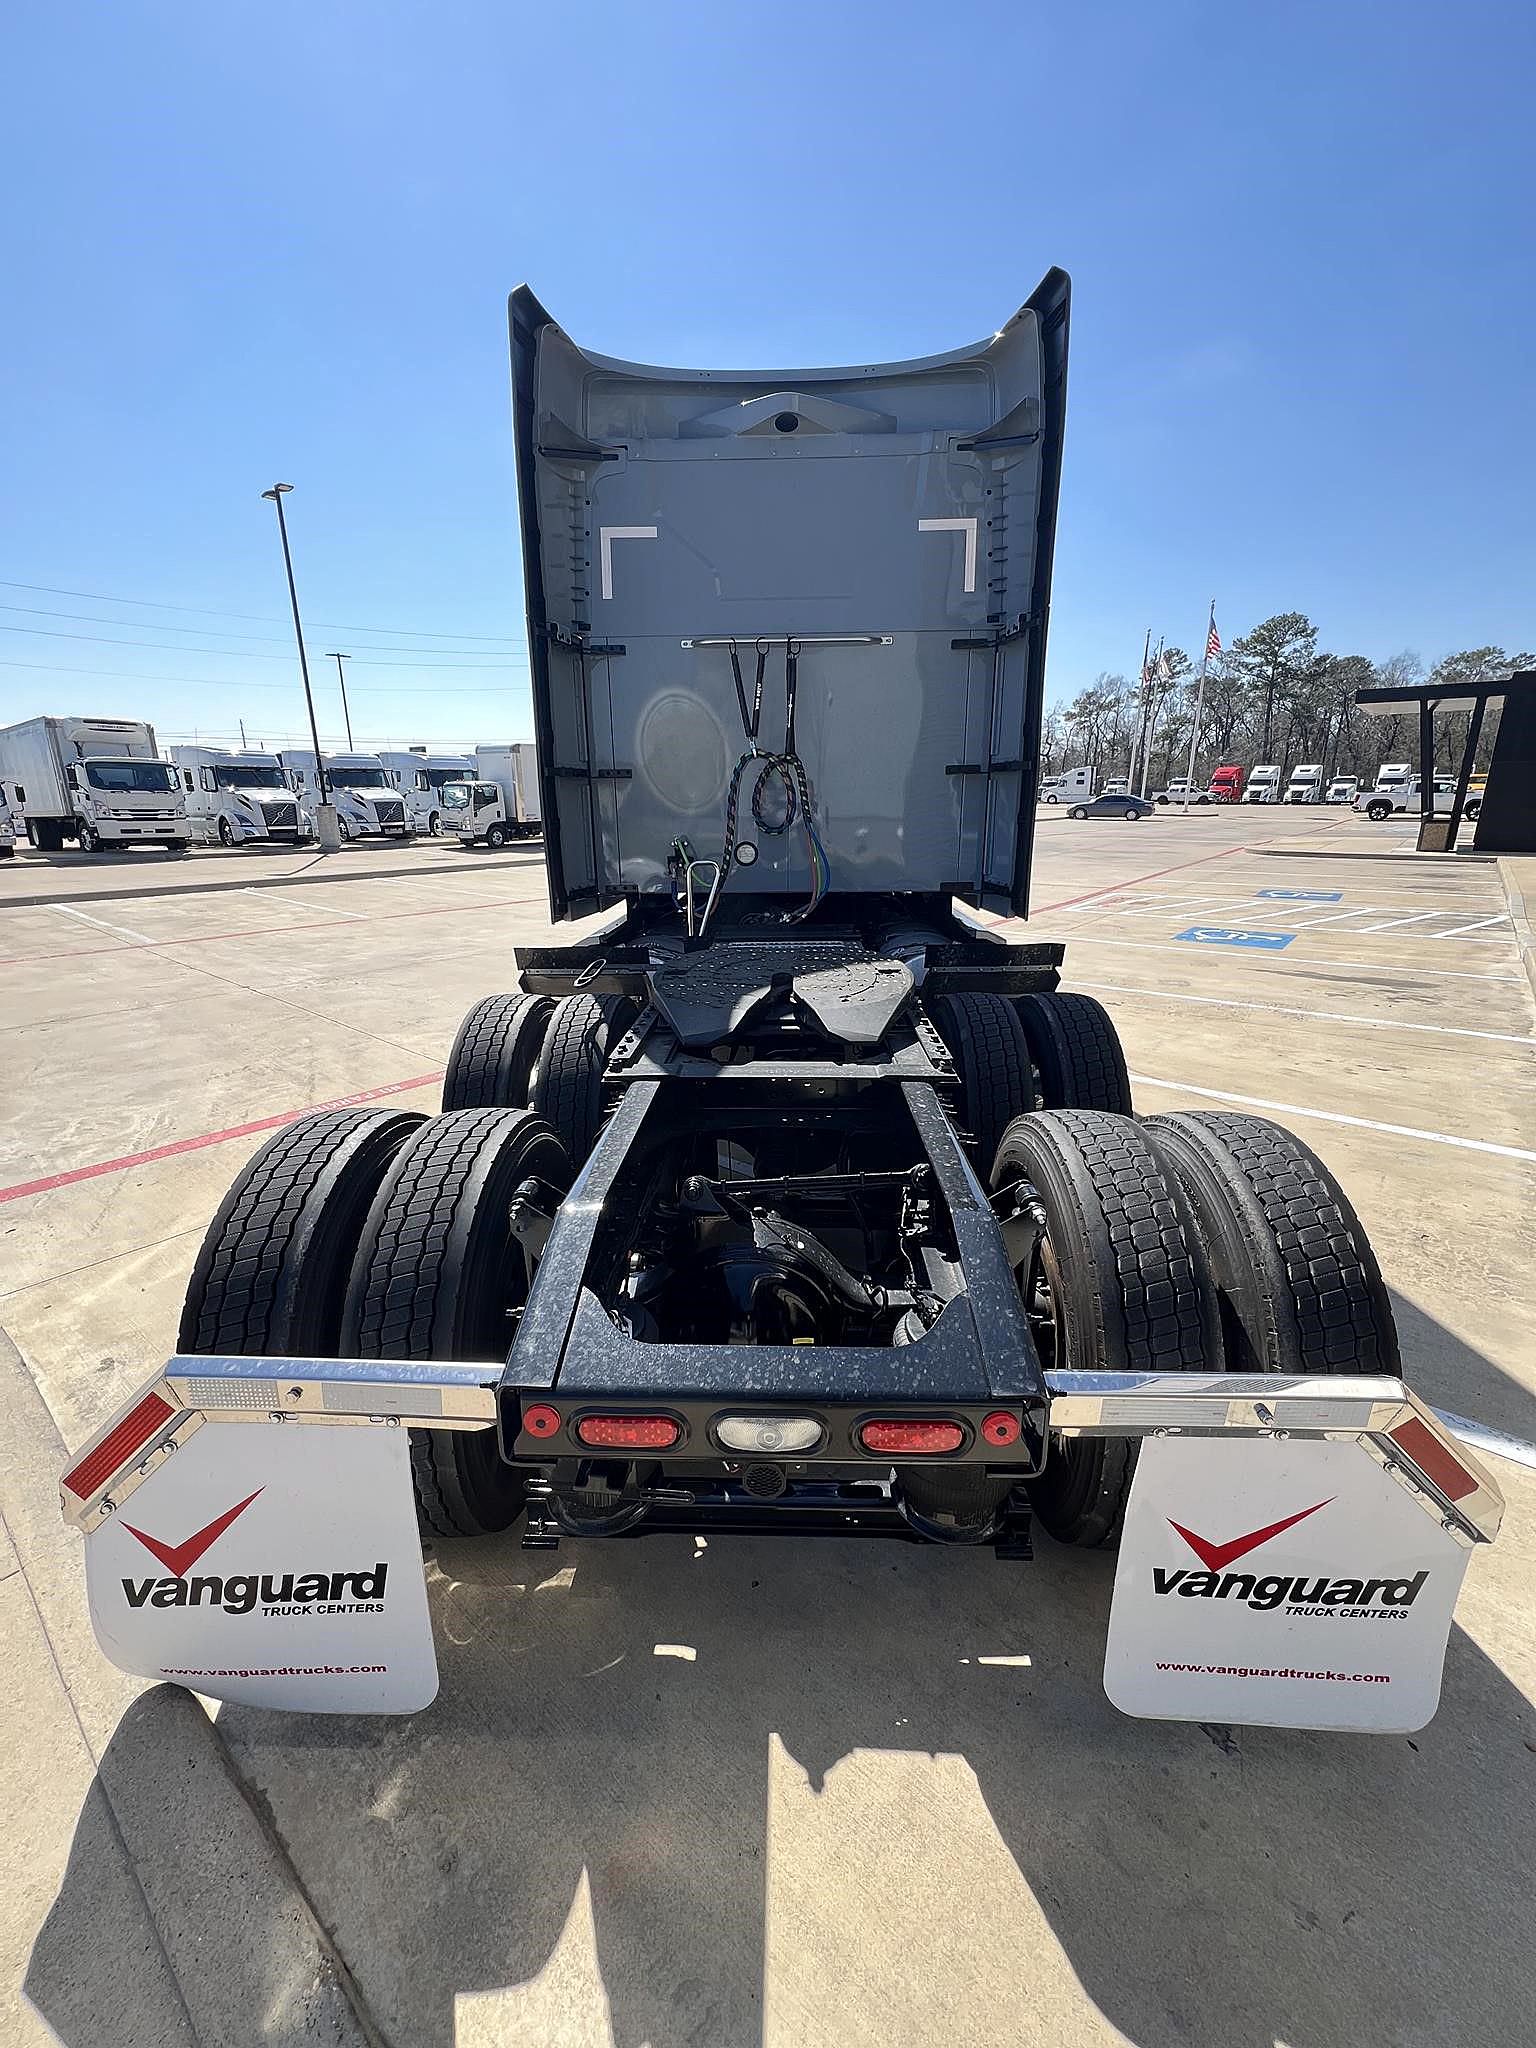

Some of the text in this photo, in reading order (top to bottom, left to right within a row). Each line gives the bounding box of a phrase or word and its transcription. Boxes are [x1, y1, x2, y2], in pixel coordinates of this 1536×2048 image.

[121, 1562, 388, 1615] vanguard
[1152, 1567, 1430, 1611] vanguard
[262, 1603, 385, 1617] TRUCK CENTERS
[1285, 1606, 1409, 1620] TRUCK CENTERS
[159, 1664, 387, 1677] www.vanguardtrucks.com
[1155, 1661, 1391, 1683] www.vanguardtrucks.com
